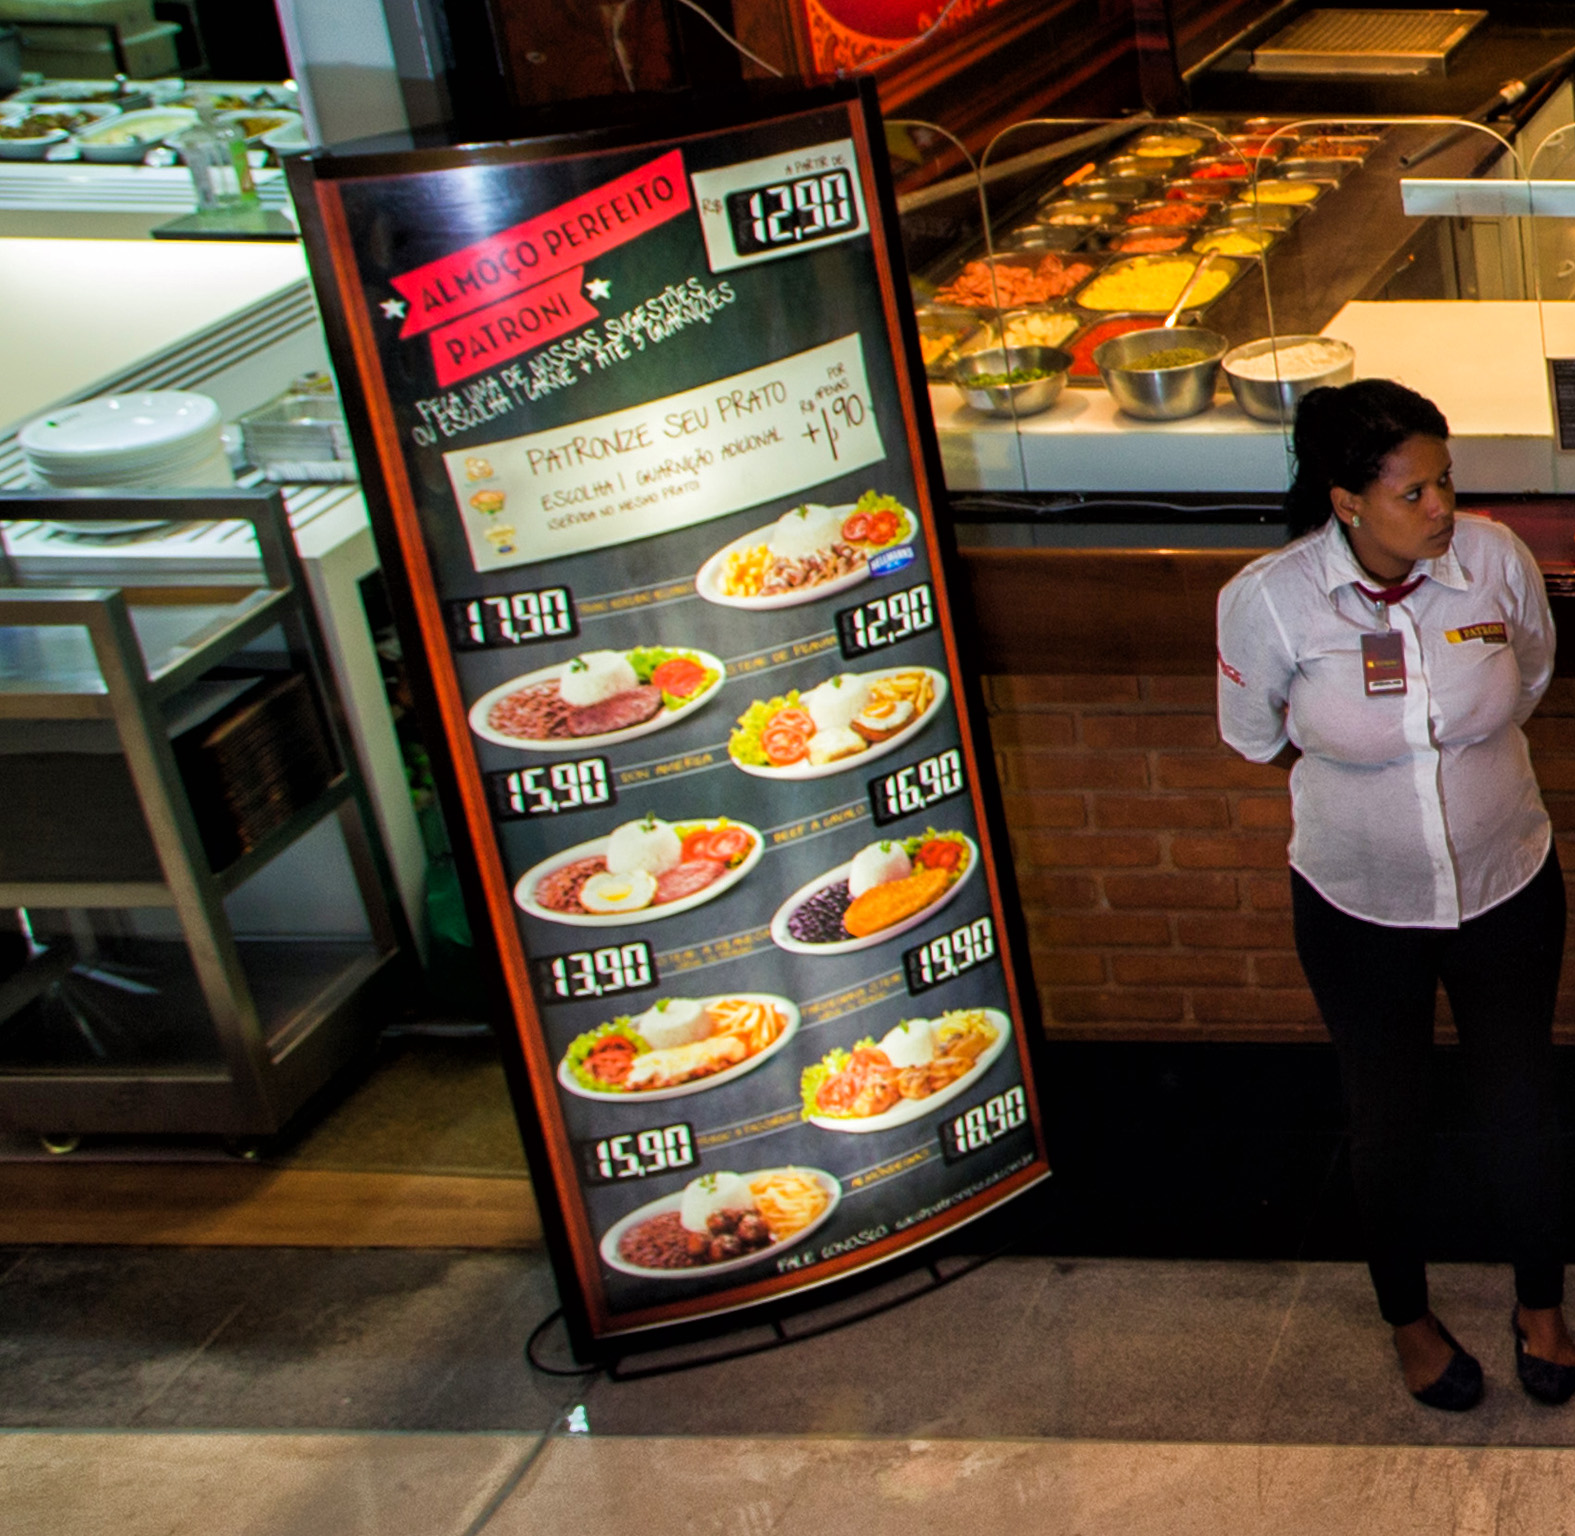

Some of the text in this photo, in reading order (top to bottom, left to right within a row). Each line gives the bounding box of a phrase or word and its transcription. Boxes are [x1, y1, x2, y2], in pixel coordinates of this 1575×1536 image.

[749, 172, 852, 244] 12,90
[420, 174, 675, 313] ALMOÇO PERFEITO
[444, 292, 573, 365] PATRONI
[528, 329, 603, 377] NOSSAS
[525, 380, 787, 476] PATRONIZE SEU PRATO
[540, 480, 614, 512] ESCOLHA
[467, 587, 572, 645] 17,90
[853, 584, 933, 649] 12,90
[506, 758, 610, 813] 15,90
[884, 748, 964, 815] 16,90
[551, 942, 652, 997] 13,90
[919, 915, 995, 984] 19,90
[596, 1123, 694, 1178] 15,90
[954, 1084, 1027, 1153] 18,90
[777, 1251, 816, 1274] FALE
